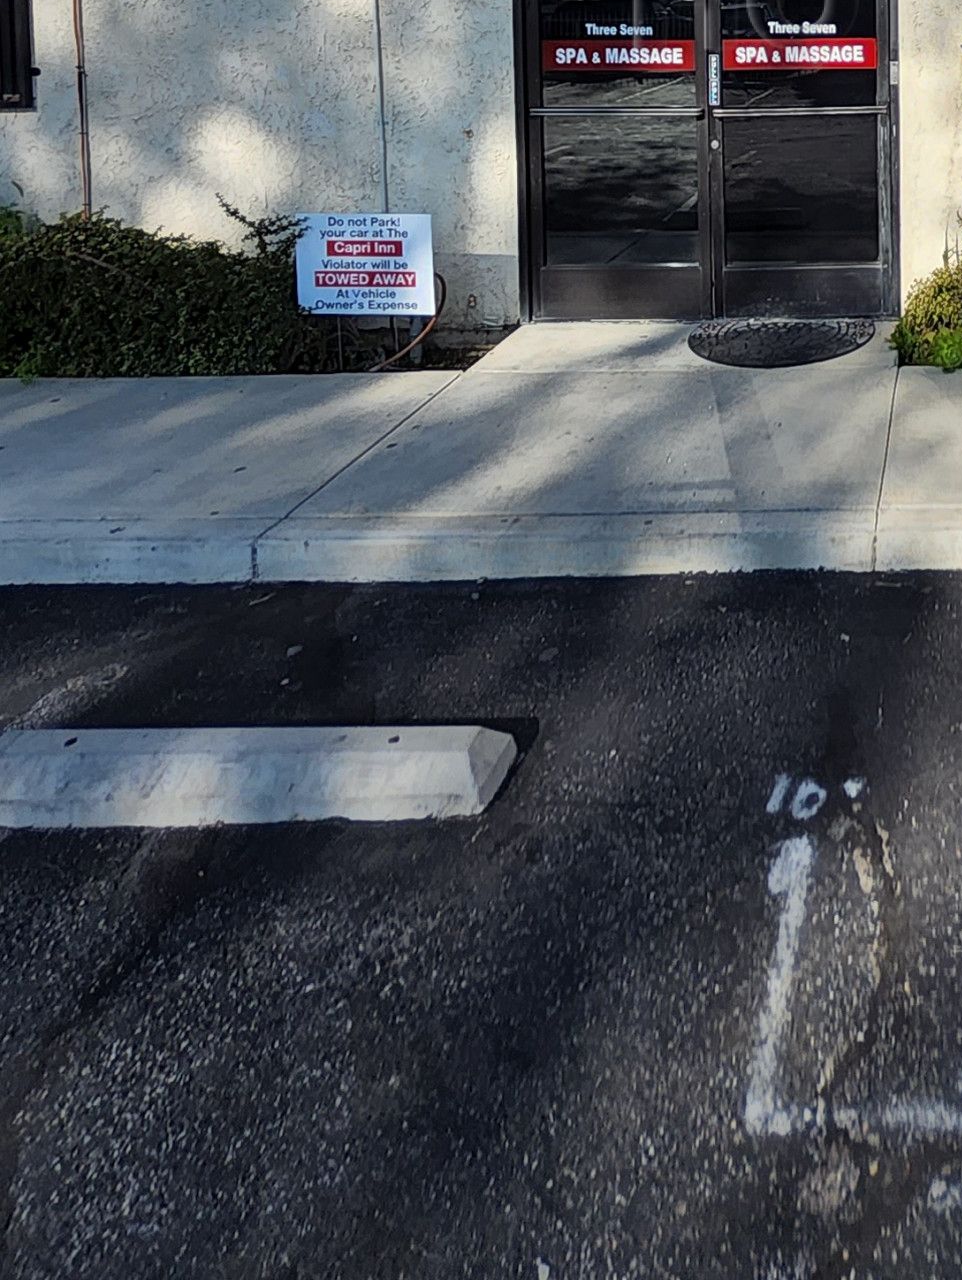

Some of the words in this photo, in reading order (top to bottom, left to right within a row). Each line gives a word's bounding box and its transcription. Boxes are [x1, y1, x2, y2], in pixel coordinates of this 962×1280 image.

[585, 23, 618, 36] Three
[620, 24, 653, 36] Seven
[768, 21, 800, 34] Three
[802, 22, 836, 35] Seven
[556, 48, 588, 64] SPA
[592, 51, 601, 64] &
[605, 47, 683, 64] MASSAGE
[735, 46, 768, 64] SPA
[772, 50, 781, 63] &
[785, 45, 864, 63] MASSAGE
[328, 217, 344, 227] Do
[347, 217, 367, 227] not
[320, 230, 346, 240] your
[349, 230, 369, 238] car
[371, 228, 384, 238] at
[387, 228, 409, 239] The
[334, 242, 371, 256] Capri
[374, 243, 396, 253] Inn
[321, 260, 368, 270] Violator
[370, 260, 391, 270] will
[393, 260, 409, 270] be
[315, 273, 369, 285] TOWED
[372, 274, 416, 286] AWAY
[336, 289, 350, 299] At
[351, 289, 397, 299] Vehicle
[315, 300, 365, 310] Owner's
[367, 300, 418, 312] Expense
